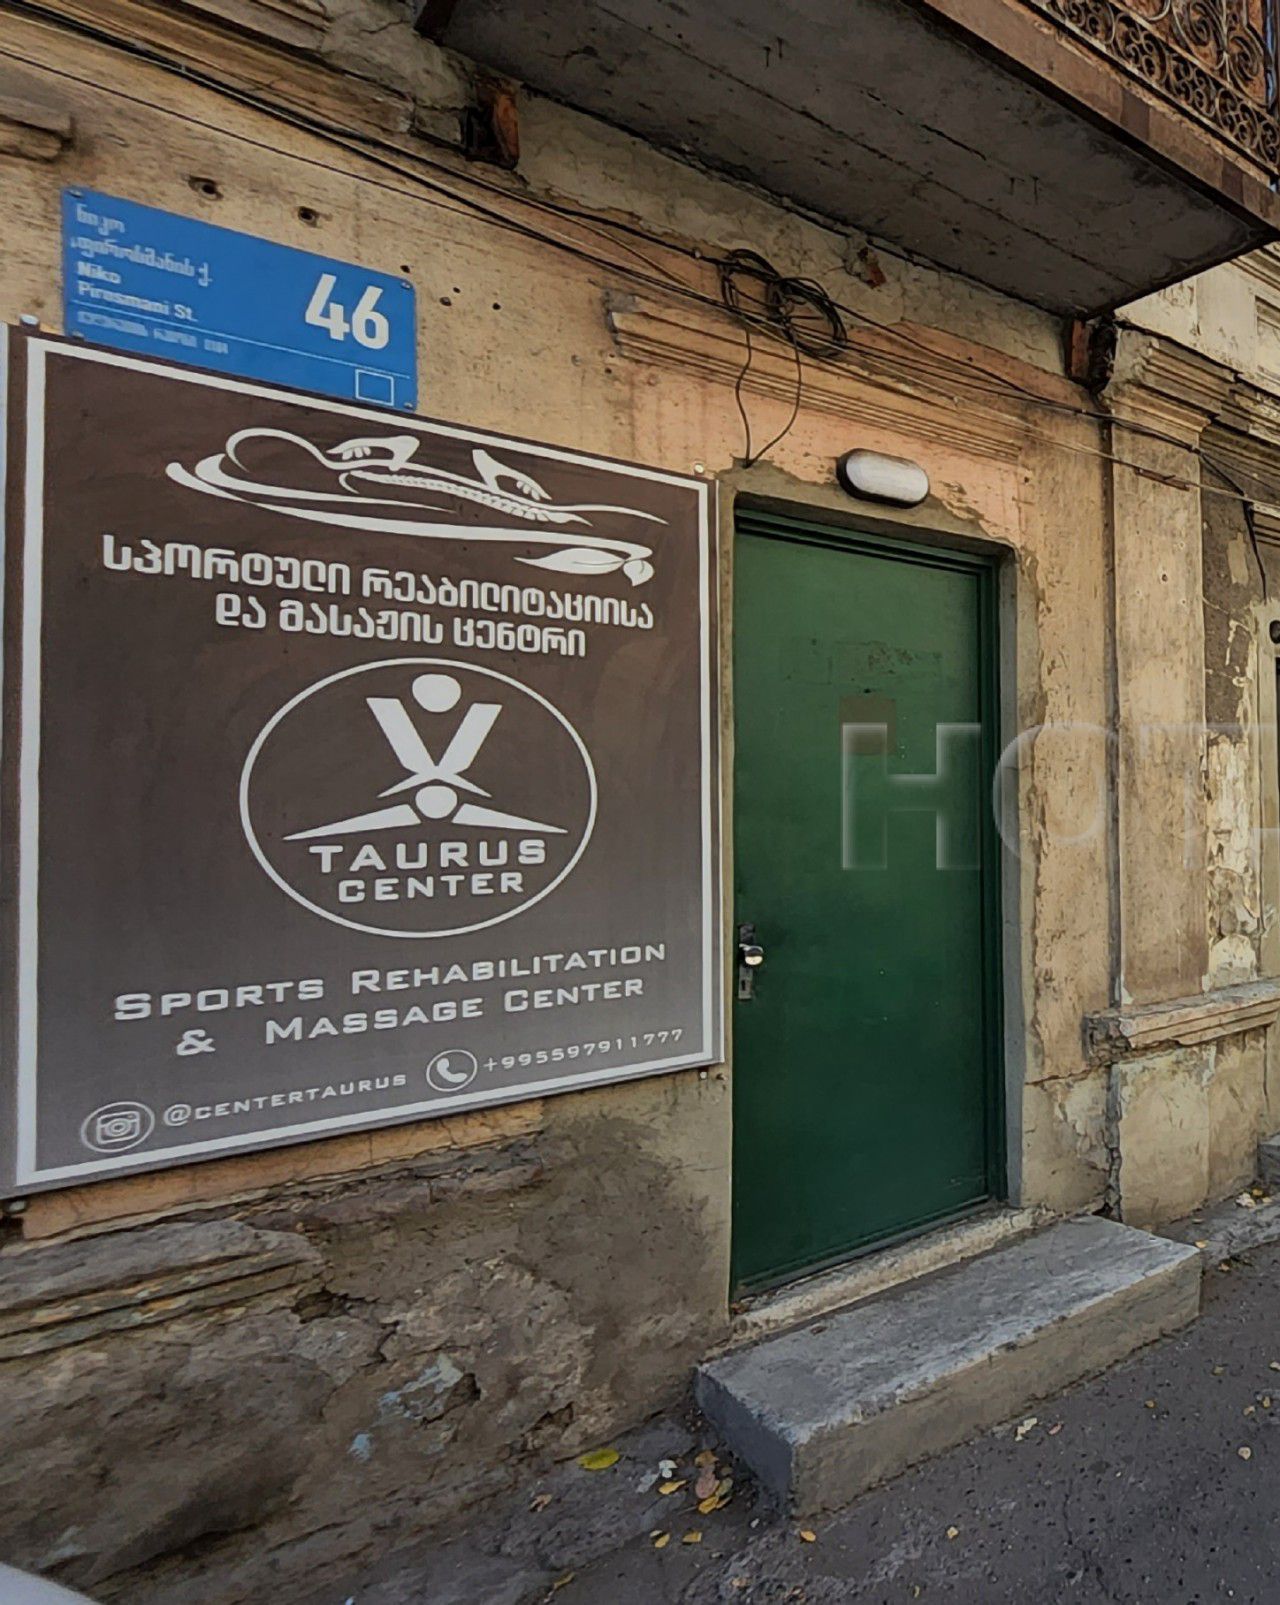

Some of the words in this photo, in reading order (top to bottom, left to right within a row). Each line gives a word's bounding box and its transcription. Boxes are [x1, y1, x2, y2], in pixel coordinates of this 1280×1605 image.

[77, 260, 121, 284] Niko
[77, 279, 170, 316] Pirosmani
[304, 272, 390, 350] 46
[103, 534, 351, 595] სპორტული
[361, 567, 654, 630] რეაბილიტაციისა
[215, 592, 267, 629] და
[279, 598, 444, 645] მასაჟის
[453, 616, 586, 658] ცენტრი
[308, 838, 546, 874] TAURUS
[338, 871, 524, 903] CENTER
[113, 978, 325, 1022] SPORTS
[351, 943, 666, 995] REHABILITATION
[176, 1029, 217, 1056] &
[265, 996, 484, 1045] MASSAGE
[504, 978, 644, 1014] CENTER
[483, 1027, 684, 1073] +995597911777
[163, 1073, 407, 1128] @CENTERTAURUS
